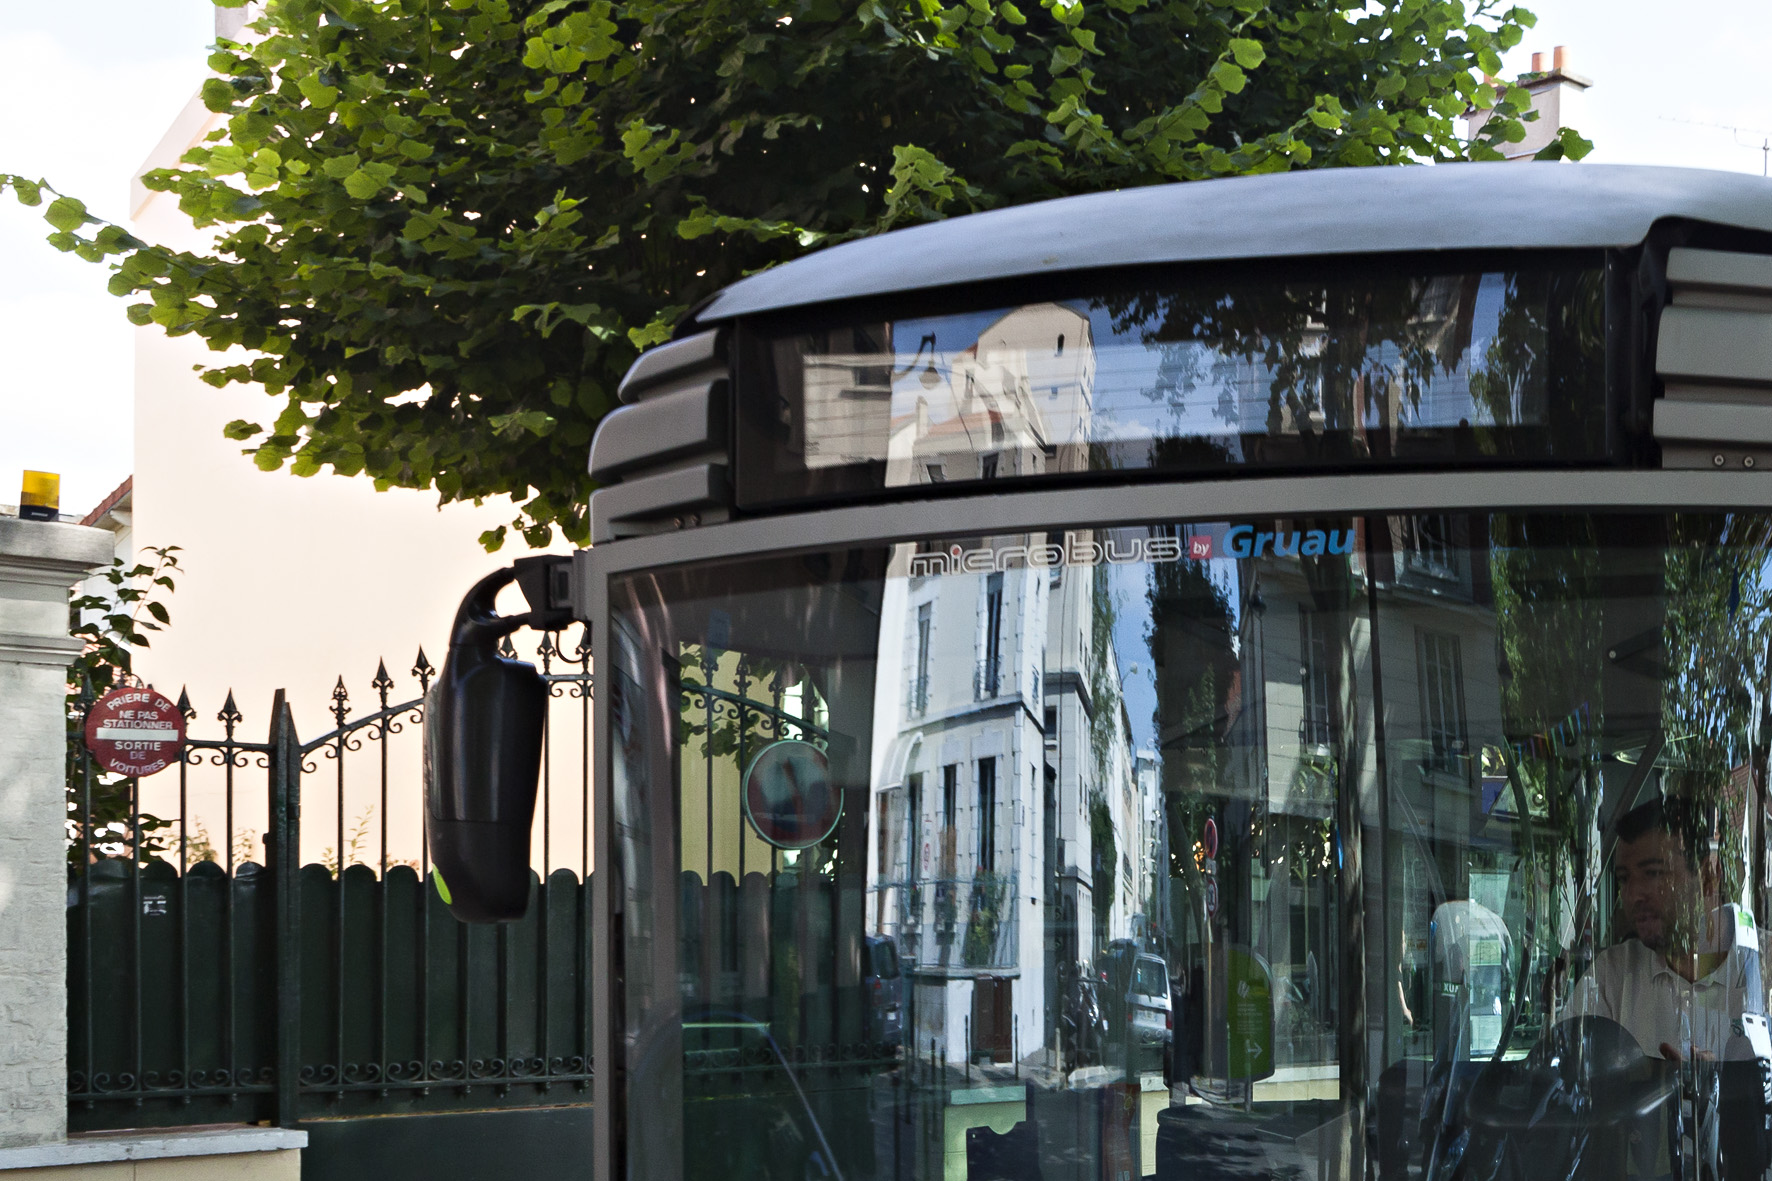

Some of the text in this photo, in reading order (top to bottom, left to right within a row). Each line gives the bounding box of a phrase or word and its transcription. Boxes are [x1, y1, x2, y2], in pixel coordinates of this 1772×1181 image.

[909, 524, 1356, 578] microbus by Gruau
[106, 692, 171, 713] PRIERE DE
[119, 710, 159, 720] NE PAS
[103, 718, 173, 730] STATIONNER
[114, 741, 161, 751] SORTIE
[129, 751, 146, 760] DE
[109, 758, 166, 775] VOITURES
